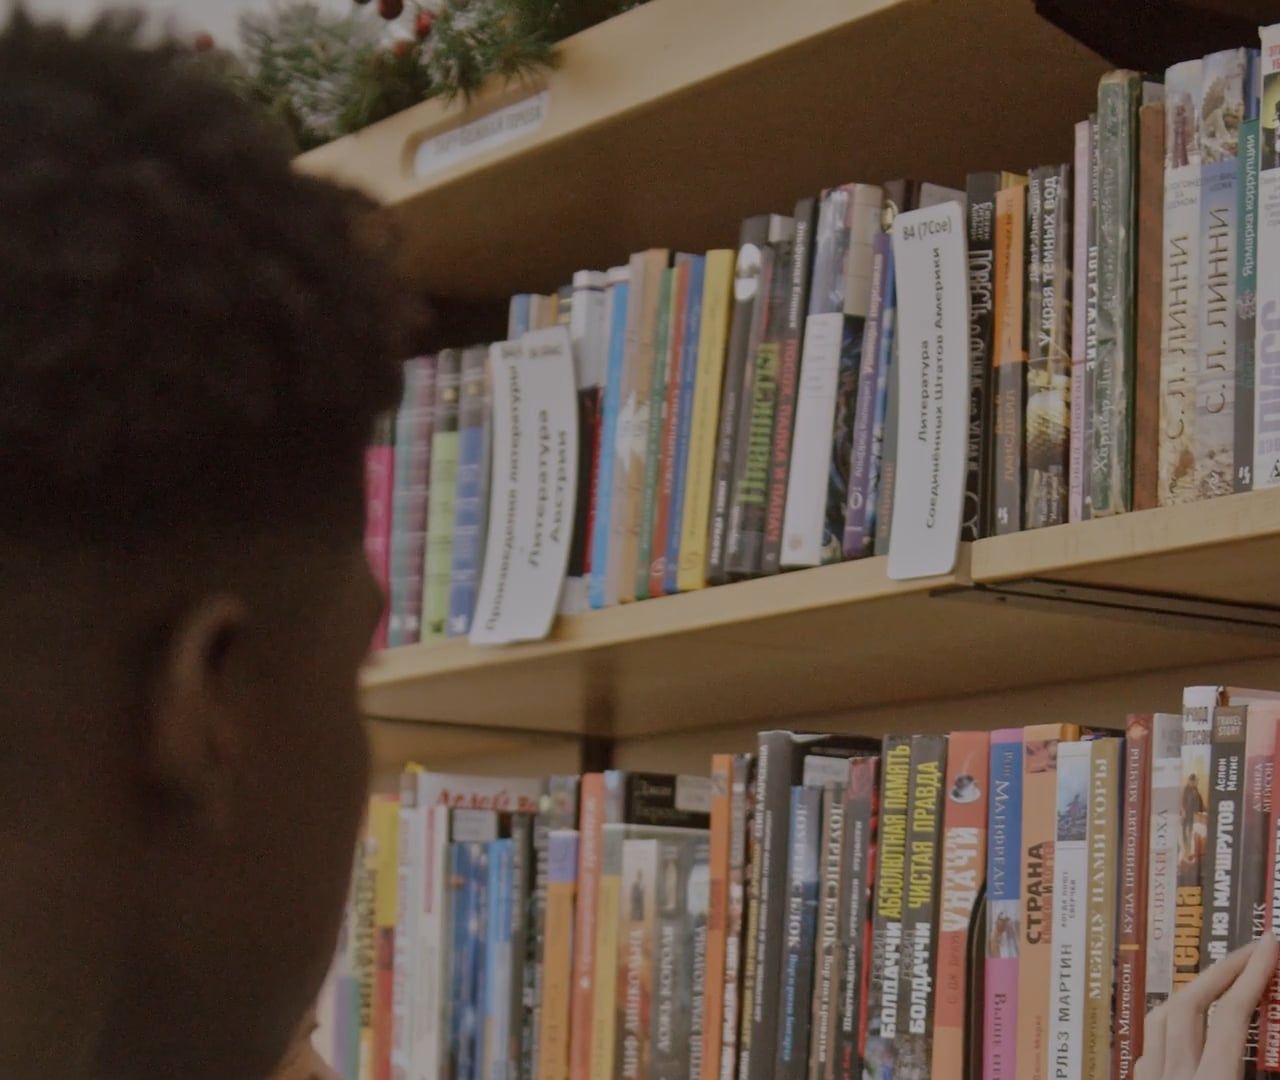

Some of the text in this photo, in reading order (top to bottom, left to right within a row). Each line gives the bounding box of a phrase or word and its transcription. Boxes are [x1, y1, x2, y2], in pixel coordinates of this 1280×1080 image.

[1242, 134, 1258, 277] Ярмарка коррупции
[932, 248, 944, 329] Америки
[1165, 234, 1188, 439] С. Л. ЛИННИ
[1206, 208, 1230, 415] С. Л. ЛИННИ
[918, 340, 930, 443] Литература
[932, 334, 944, 402] Штатов
[1216, 757, 1228, 791] Аспен
[1227, 756, 1240, 791] Матис
[822, 801, 843, 894] ЛОУРЕНС
[878, 745, 913, 918] АБСОЛЮТНАЯ ПАМЯТЬ
[907, 760, 942, 909] ЧИСТАЯ ПРАВДА
[1088, 757, 1108, 1000] МЕЖДУ НАМИ ГОРЫ
[1124, 748, 1141, 934] КУДА ПРИВОДЯТ МЕЧТЫ
[1152, 808, 1169, 941] ОТЗВУКИ ЭХА
[1213, 799, 1235, 907] МАРШРУТОВ
[820, 897, 839, 949] БЛОК
[1025, 842, 1044, 945] СТРАНА
[1212, 912, 1231, 936] ИЗ
[822, 954, 834, 979] Вор
[879, 922, 903, 1038] БОЛДАЧЧИ
[909, 922, 931, 1034] БОЛДАЧЧИ
[1057, 943, 1073, 1022] МАРТИН
[1117, 962, 1133, 1035] Матесон
[992, 992, 1006, 1048] ВЫШЕ
